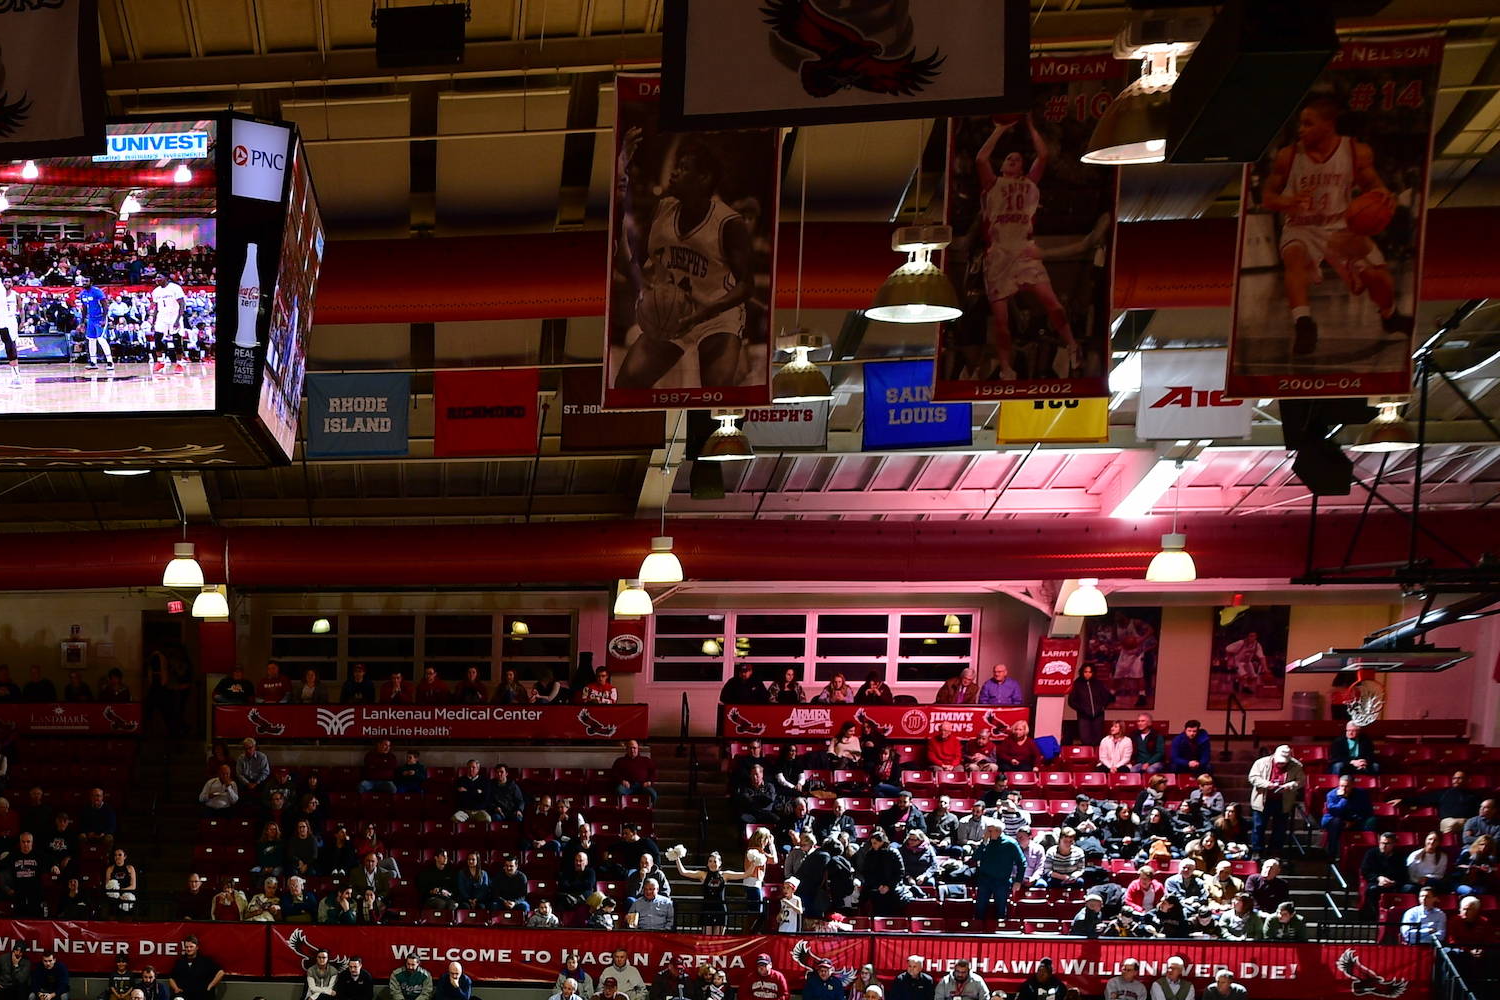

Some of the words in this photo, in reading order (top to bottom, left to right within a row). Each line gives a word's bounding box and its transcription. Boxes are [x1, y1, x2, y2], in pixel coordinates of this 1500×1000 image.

[1351, 44, 1431, 63] NELSON
[1040, 61, 1107, 77] MORAN
[1349, 79, 1424, 110] #14
[112, 133, 207, 152] UNIVEST
[251, 149, 284, 171] PNC
[241, 299, 257, 308] zero
[234, 349, 255, 359] REAL
[885, 387, 935, 403] SAIN
[328, 397, 388, 414] RHODE
[323, 416, 392, 434] ISLAND
[888, 408, 947, 426] LOUIS
[1037, 678, 1072, 686] STEAKS
[29, 712, 90, 724] LANDMARK
[362, 707, 432, 721] Lankenau
[434, 708, 490, 721] Medical
[493, 708, 543, 721] Center
[782, 707, 831, 727] ARMEN
[930, 711, 974, 723] JIMMY
[362, 726, 385, 736] Main
[389, 726, 413, 736] Line
[929, 723, 974, 734] JON'S
[53, 937, 128, 955] NEVER
[391, 945, 512, 964] WELCOME
[521, 950, 552, 964] TO
[561, 949, 649, 967] HAGN
[1060, 959, 1122, 977] WILL
[1239, 962, 1297, 981] DIE!
